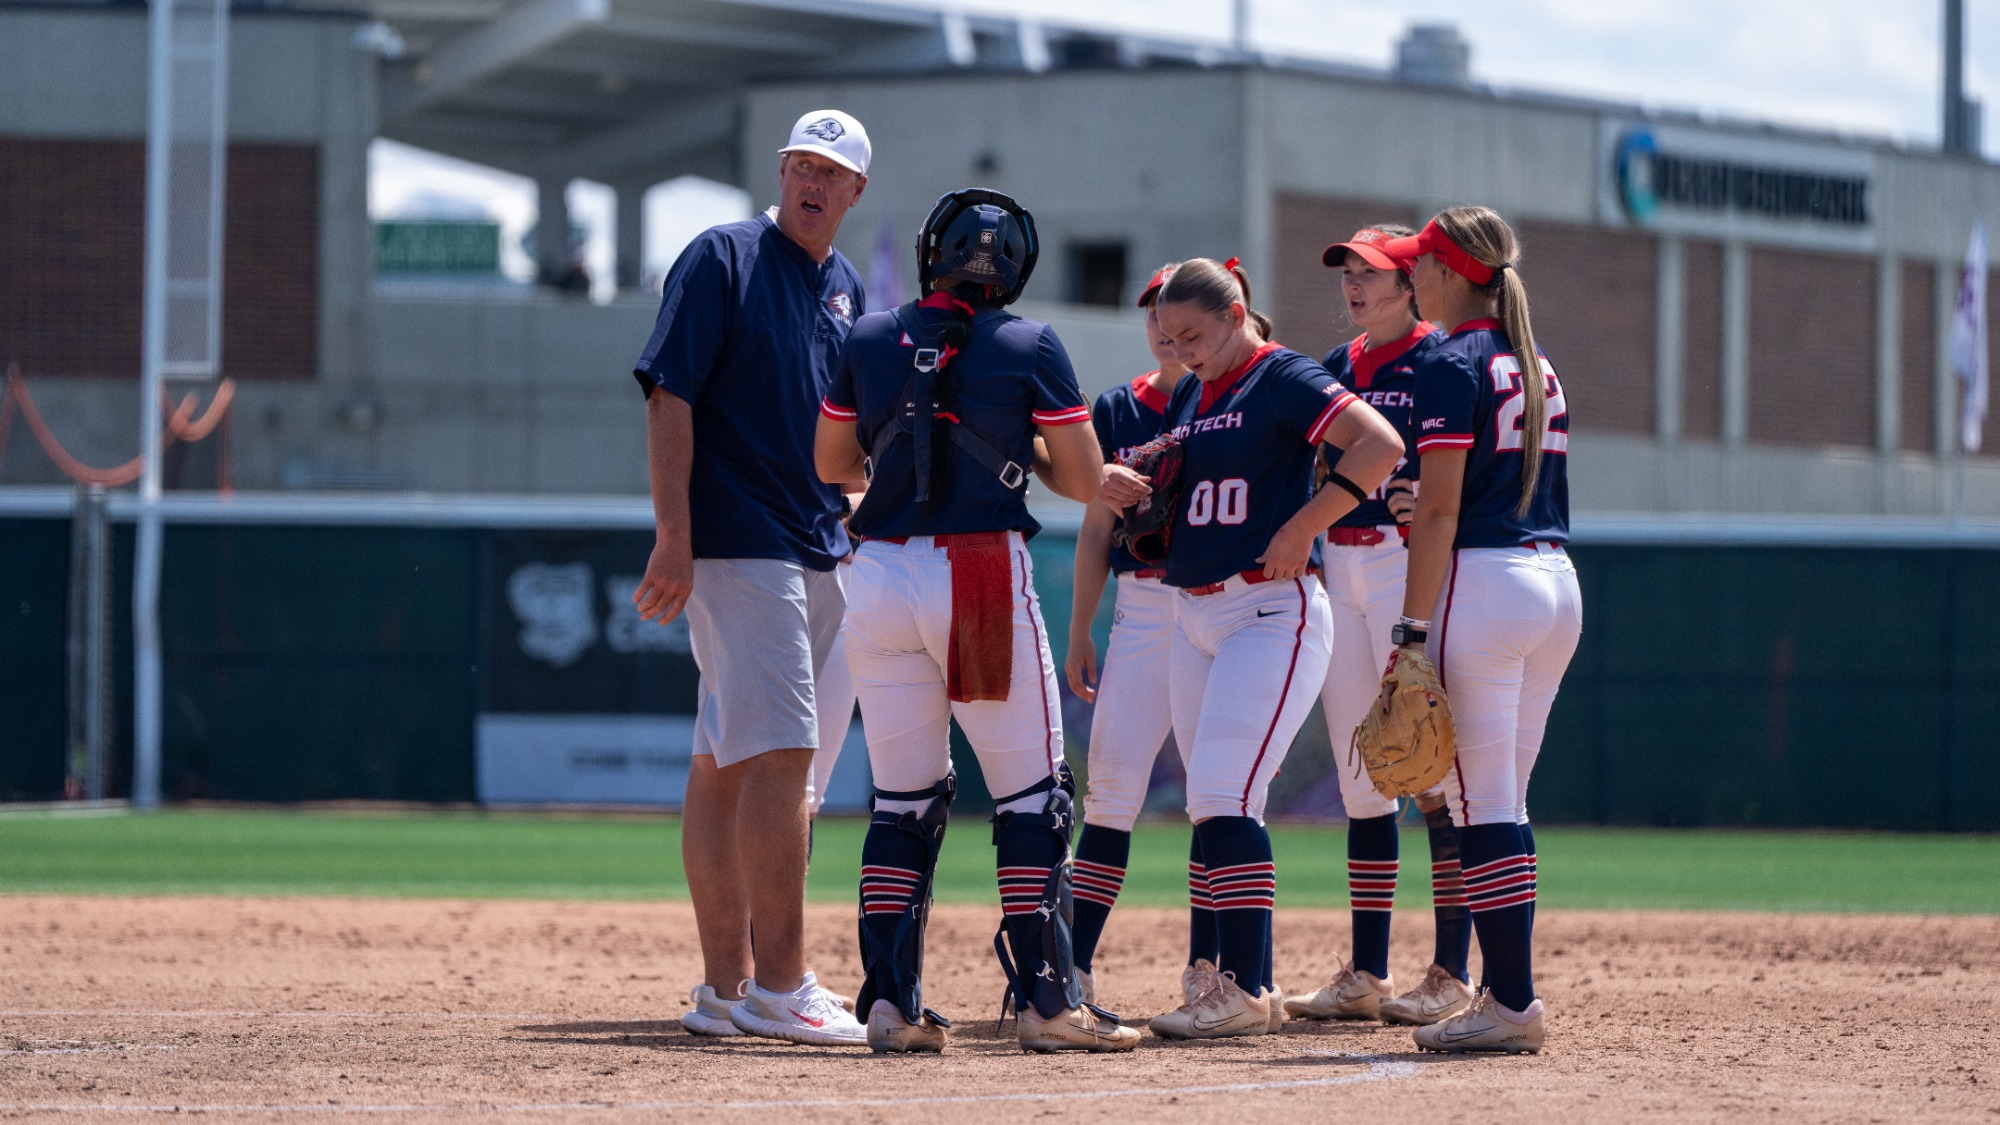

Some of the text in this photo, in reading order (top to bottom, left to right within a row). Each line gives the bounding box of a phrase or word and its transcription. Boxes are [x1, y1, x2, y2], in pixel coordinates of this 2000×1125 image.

[1487, 353, 1569, 456] 22
[1194, 411, 1243, 435] TECH
[1421, 418, 1446, 430] WAC
[1187, 478, 1249, 527] 00
